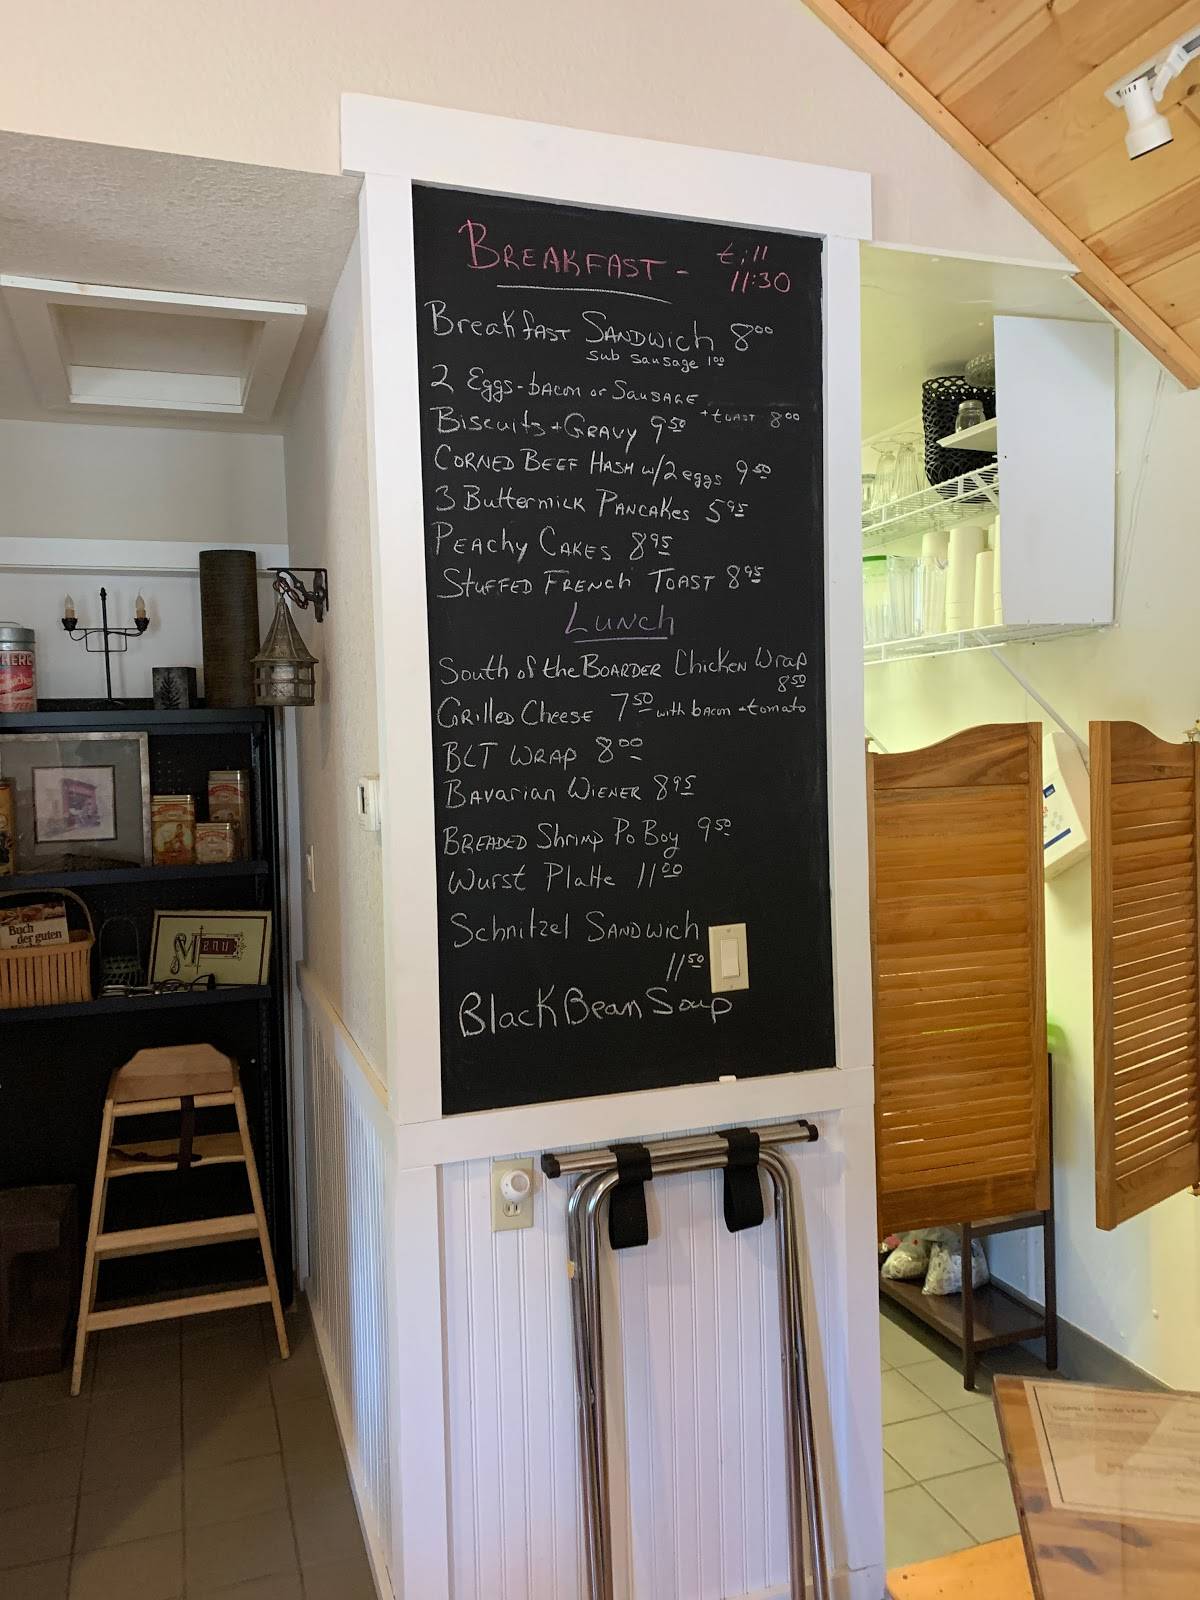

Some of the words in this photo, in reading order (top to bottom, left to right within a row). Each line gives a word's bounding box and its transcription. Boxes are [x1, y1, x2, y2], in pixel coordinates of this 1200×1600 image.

[457, 218, 667, 281] BREAKFAST
[716, 242, 768, 265] till
[730, 270, 791, 294] 11:30
[585, 347, 620, 362] sub
[630, 353, 700, 374] sausage
[430, 363, 455, 394] 2
[590, 387, 608, 397] or
[429, 405, 547, 437] Biscuits
[434, 443, 515, 473] CORNED
[519, 447, 579, 472] BEEF
[589, 449, 635, 475] HASH
[681, 469, 723, 490] eggs
[435, 484, 456, 512] 3
[539, 524, 612, 561] CAKES
[647, 567, 716, 594] TOAST
[438, 653, 509, 685] South
[516, 654, 537, 680] of
[541, 654, 579, 679] the
[579, 653, 662, 679] BOARDER
[754, 646, 808, 671] Wrap
[656, 700, 686, 718] with
[509, 744, 577, 771] WRAP
[442, 825, 528, 856] BREADED
[536, 822, 604, 854] Shrimp
[612, 816, 636, 846] Po
[641, 819, 681, 860] Boy
[447, 863, 526, 895] Wurst
[9, 923, 34, 936] Buch
[35, 930, 63, 944] guten
[450, 907, 569, 949] Schnitzel
[563, 986, 643, 1026] Bean
[644, 984, 733, 1025] Soup
